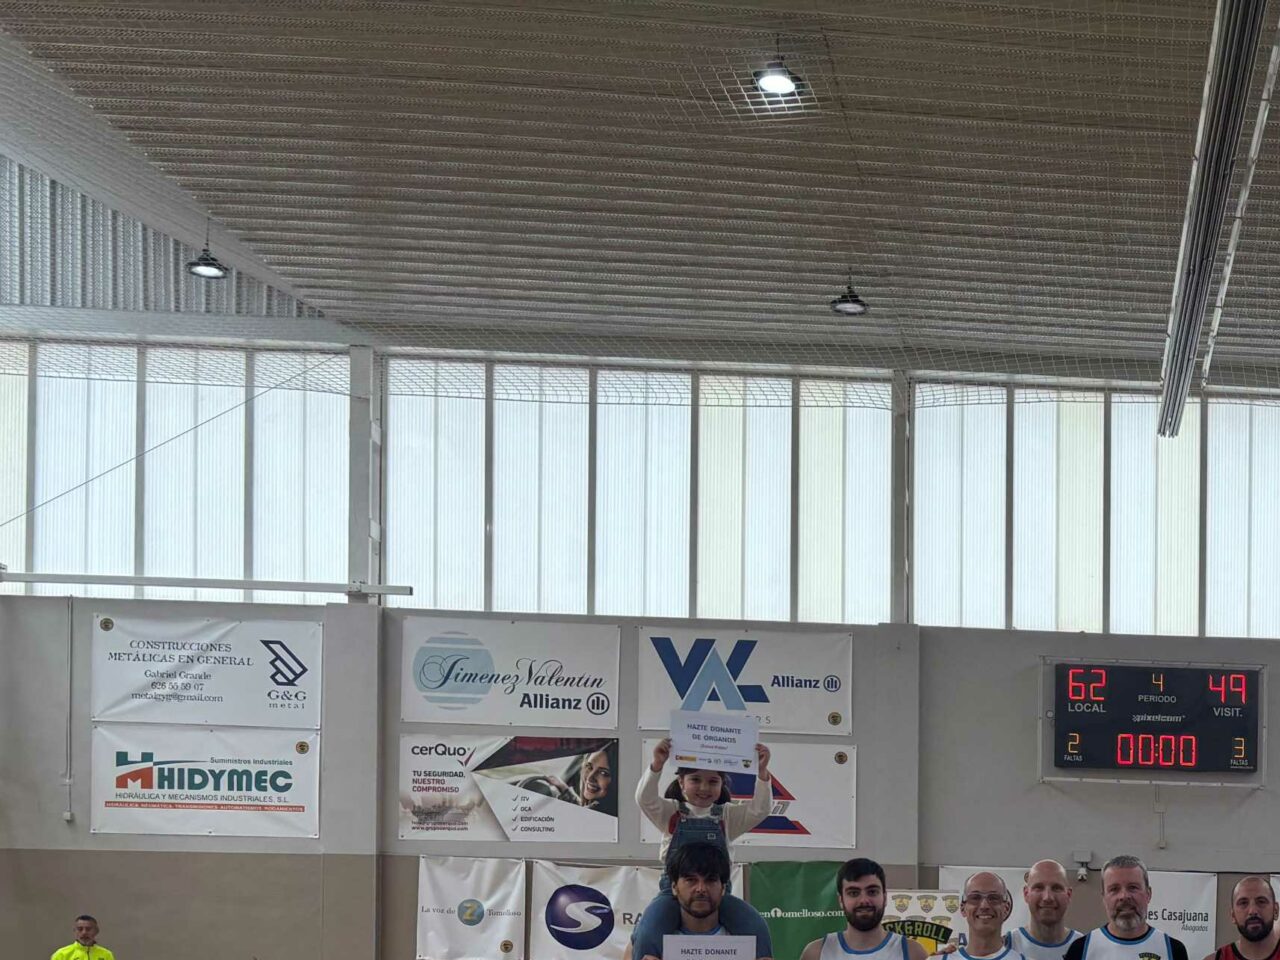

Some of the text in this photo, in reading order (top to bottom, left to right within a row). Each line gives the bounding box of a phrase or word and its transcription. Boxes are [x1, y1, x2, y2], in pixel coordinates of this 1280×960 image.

[130, 640, 232, 652] CONSTRUCCIONES
[108, 652, 254, 666] METÁLICAS EN GENERAL
[144, 670, 212, 680] Gabriel Grande
[771, 675, 820, 689] Allianz
[1068, 669, 1106, 701] 62
[1152, 673, 1163, 692] 4
[1209, 674, 1246, 705] 49
[267, 689, 307, 701] G&G
[520, 693, 581, 710] Allianz
[1138, 695, 1177, 703] PERIODO
[1068, 703, 1106, 713] LOCAL
[1213, 707, 1243, 717] VISIT.
[411, 743, 467, 757] cerQuo
[1068, 733, 1079, 753] 2
[1234, 738, 1245, 758] 3
[1117, 734, 1196, 767] 00:00
[210, 757, 293, 766] Suministros Industriales
[1064, 754, 1082, 762] FALTAS
[157, 767, 293, 793] HIDYMEC
[1162, 908, 1209, 923] Casajuana
